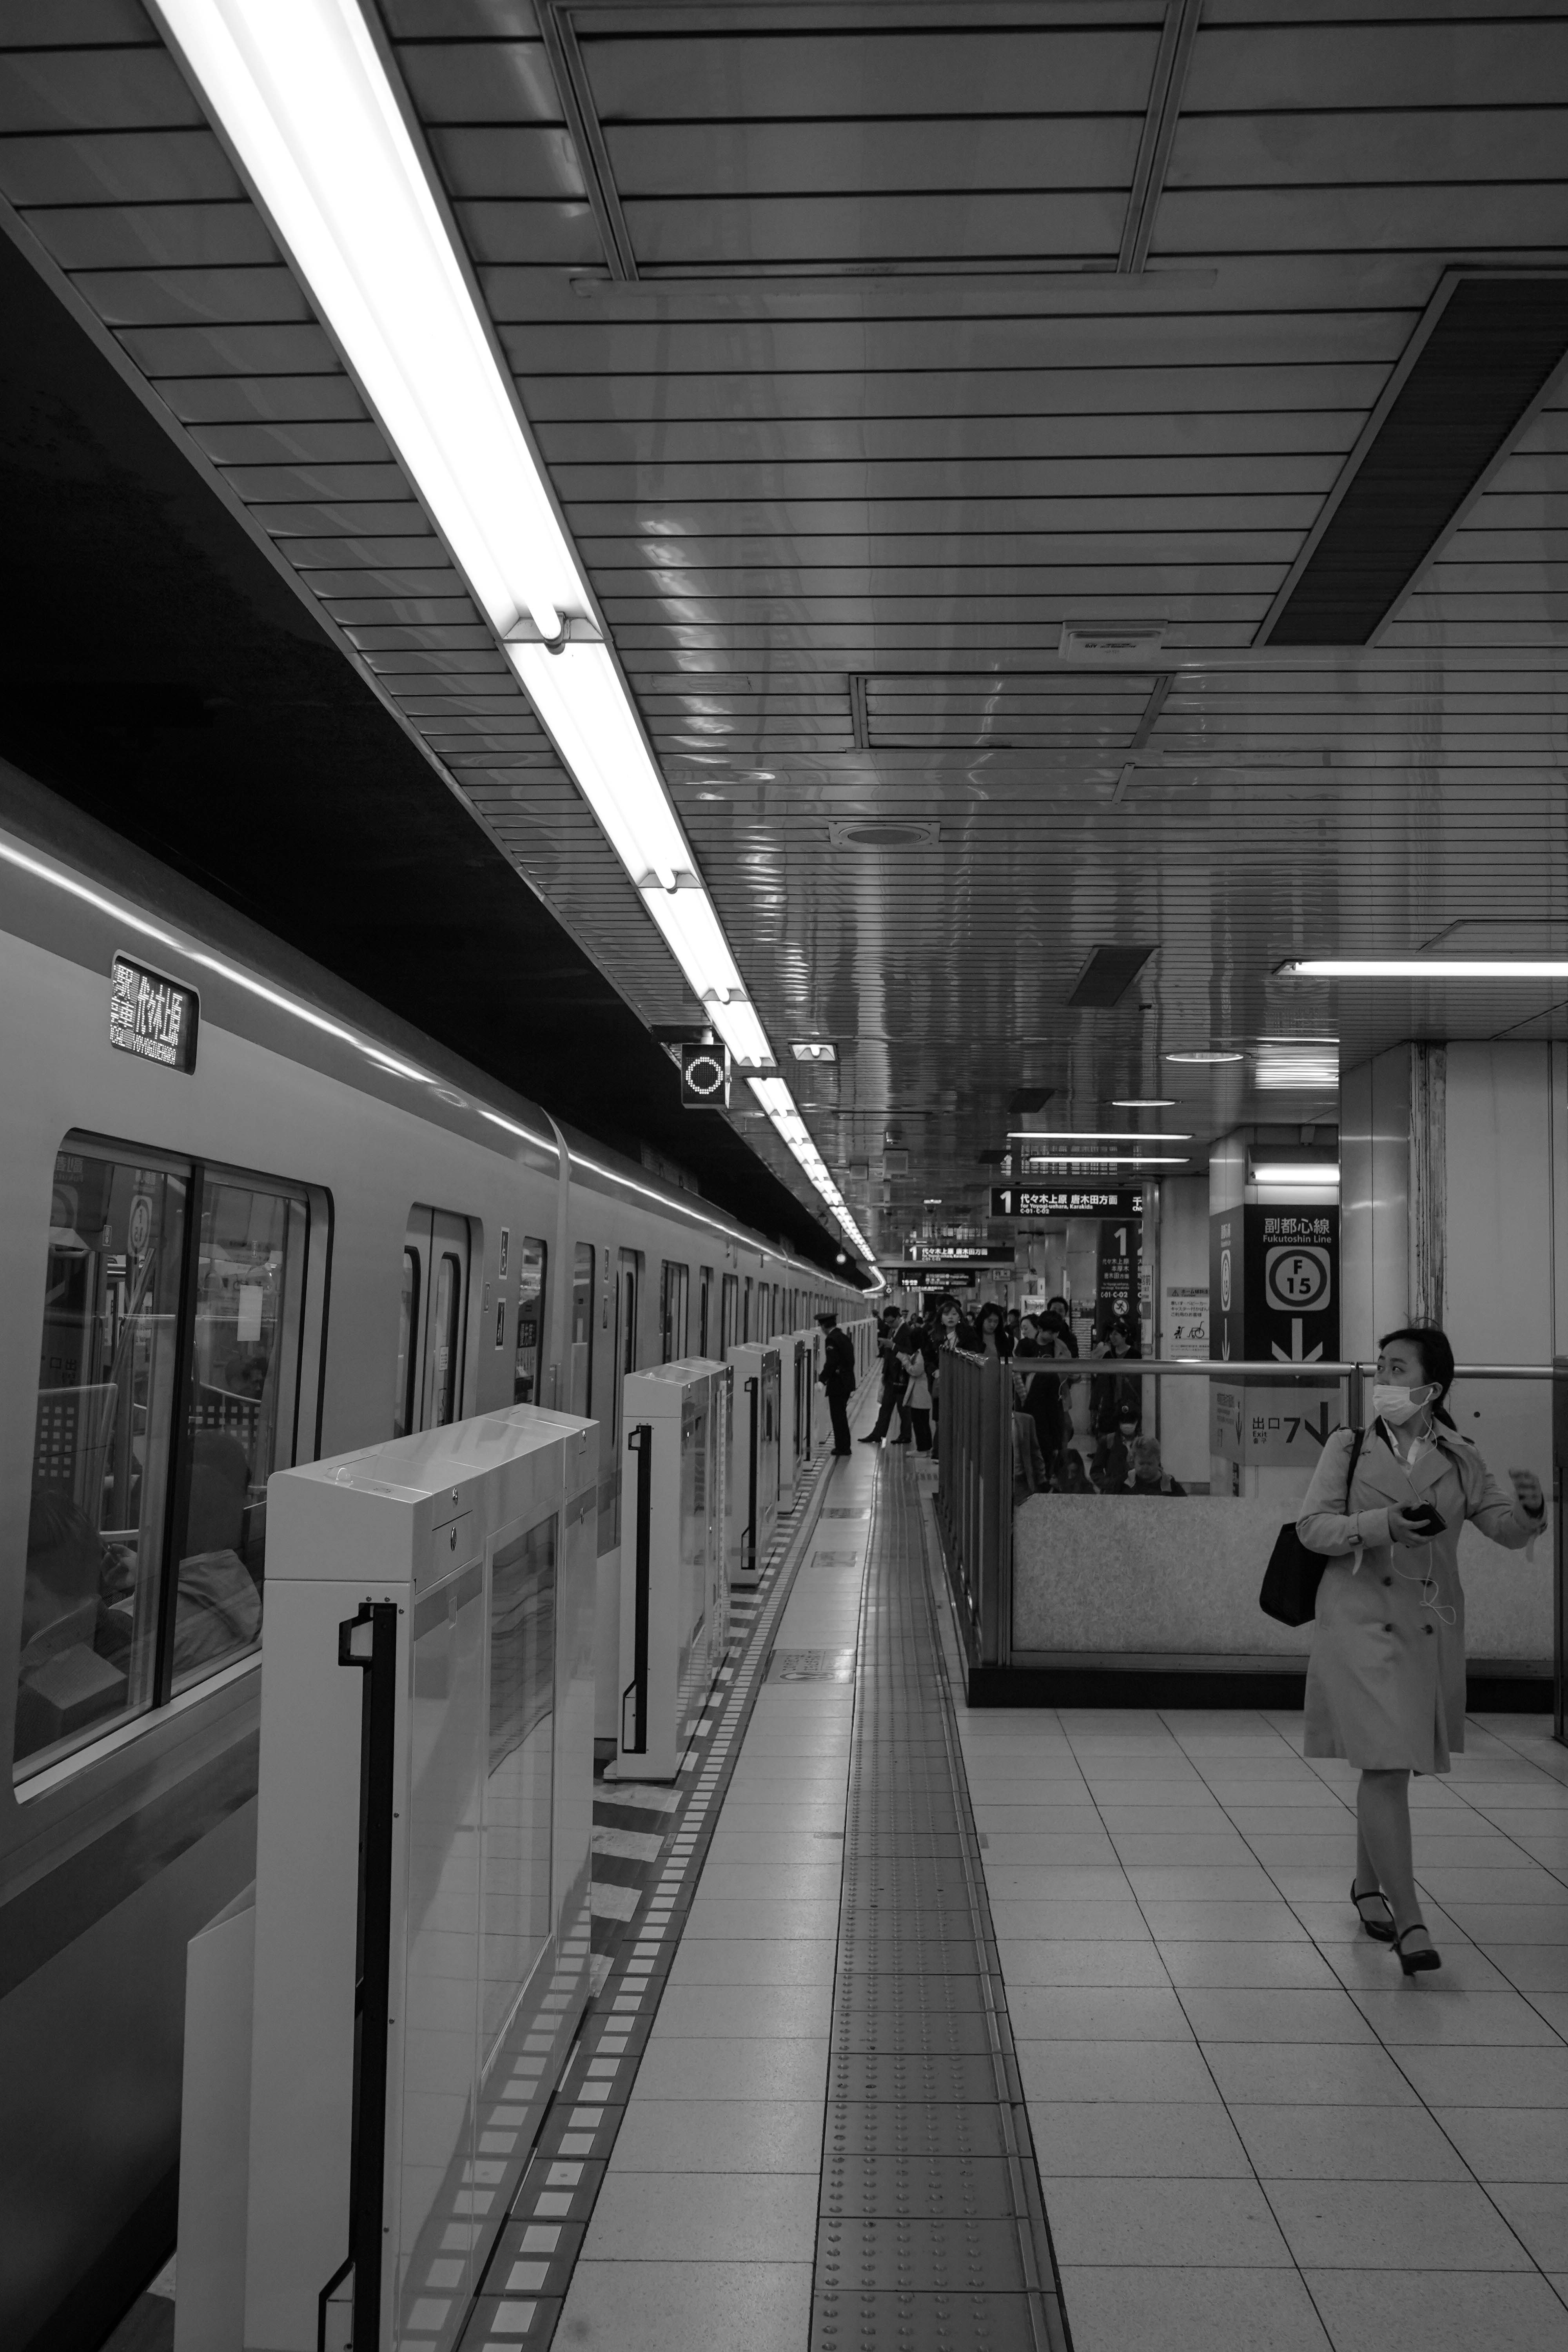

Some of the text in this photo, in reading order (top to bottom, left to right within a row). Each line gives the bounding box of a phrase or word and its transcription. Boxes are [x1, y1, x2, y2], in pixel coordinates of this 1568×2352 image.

[136, 976, 183, 1046] 代々木上原
[1000, 1191, 1118, 1213] 1 代々木上原 唐木田方面
[1265, 1218, 1330, 1234] 副都心線
[1114, 1227, 1126, 1256] 1
[1263, 1235, 1311, 1243] Fukutoshin
[1294, 1259, 1303, 1274] F
[1287, 1278, 1311, 1294] 15
[1252, 1417, 1280, 1430] 出口
[1284, 1417, 1301, 1443] 7
